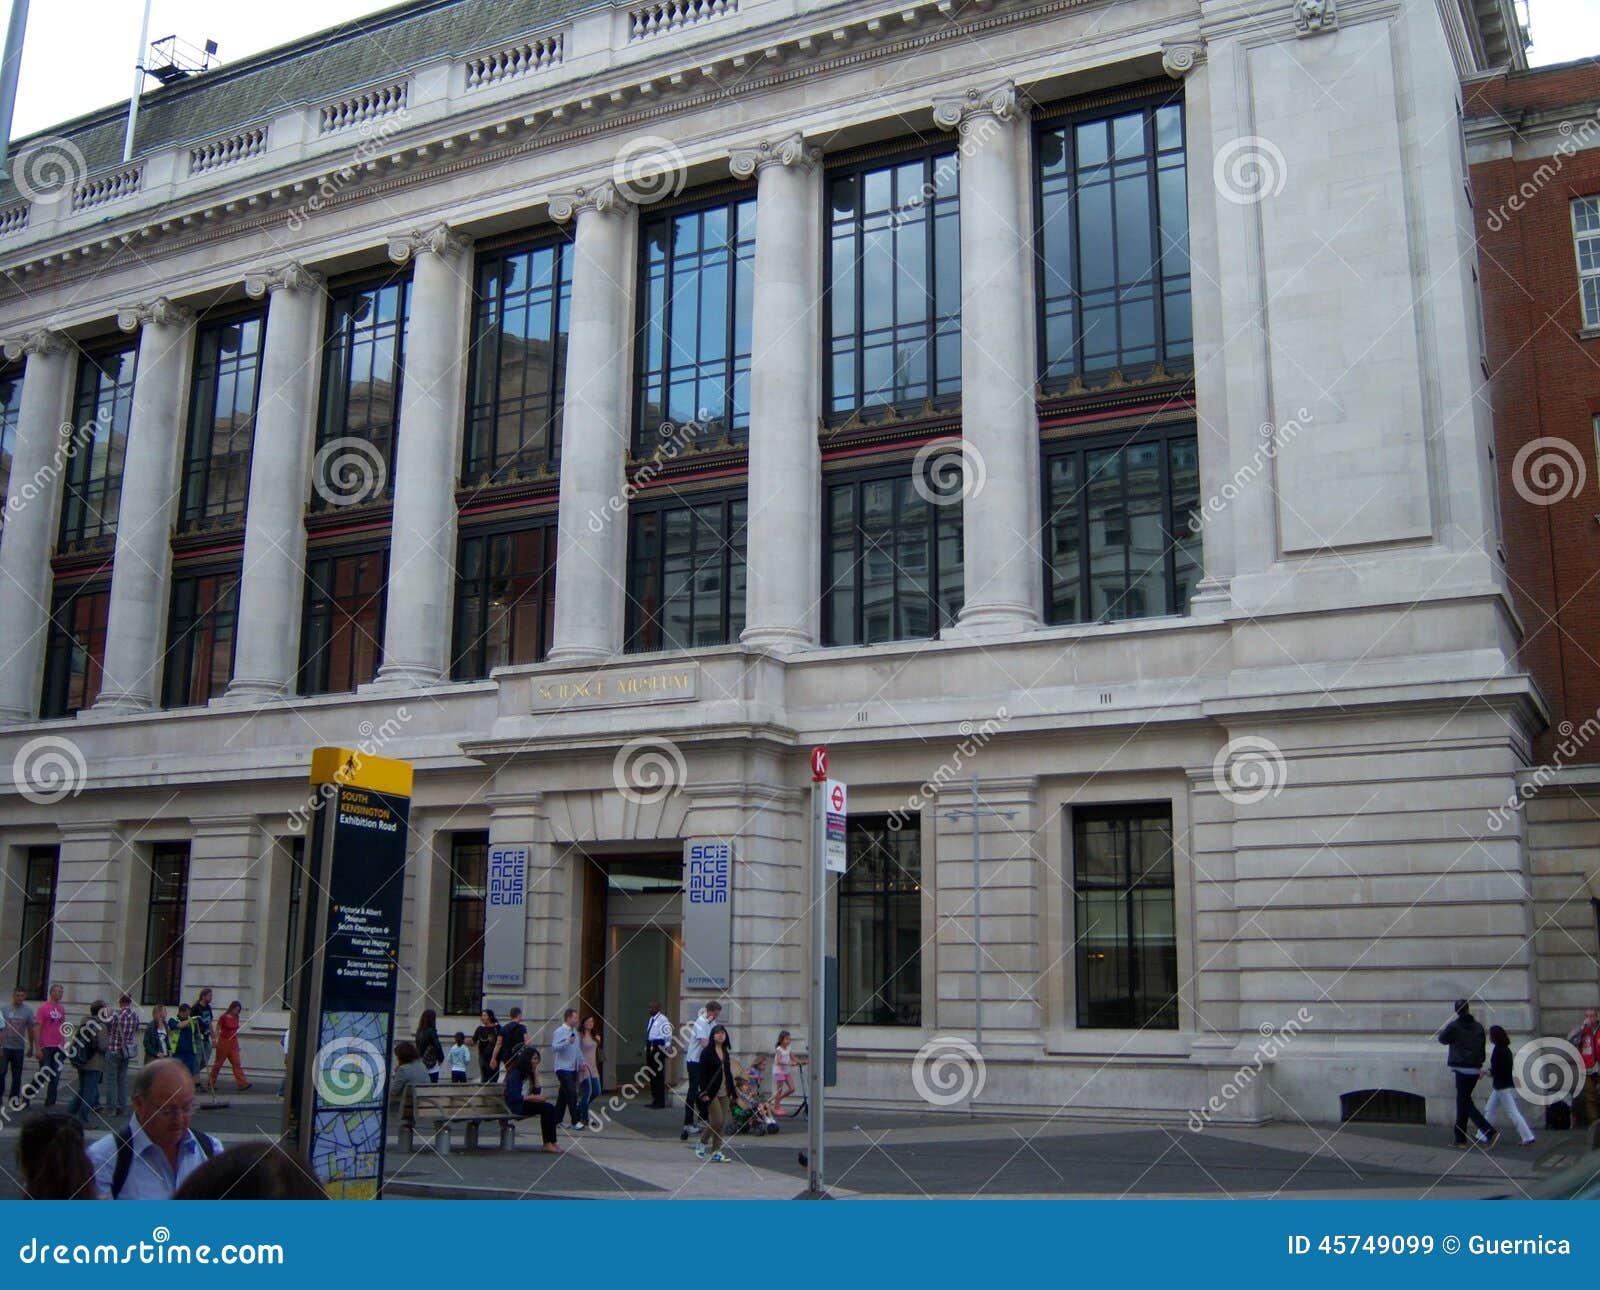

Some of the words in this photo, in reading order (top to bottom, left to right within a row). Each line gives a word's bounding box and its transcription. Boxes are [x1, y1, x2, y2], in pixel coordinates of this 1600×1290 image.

[538, 680, 607, 700] SCIENCE
[616, 673, 689, 694] MUSEUM
[816, 751, 826, 773] K
[342, 791, 369, 804] SOUTH
[341, 803, 390, 819] KENSINGTON
[340, 814, 377, 828] Exhibition
[378, 820, 397, 832] Road
[366, 908, 382, 916] Albert
[338, 923, 353, 931] South
[354, 924, 383, 934] Kensington
[351, 938, 371, 946] Natural
[372, 939, 390, 949] History
[347, 960, 367, 968] Science
[343, 968, 359, 976] South
[360, 969, 388, 979] Kensington
